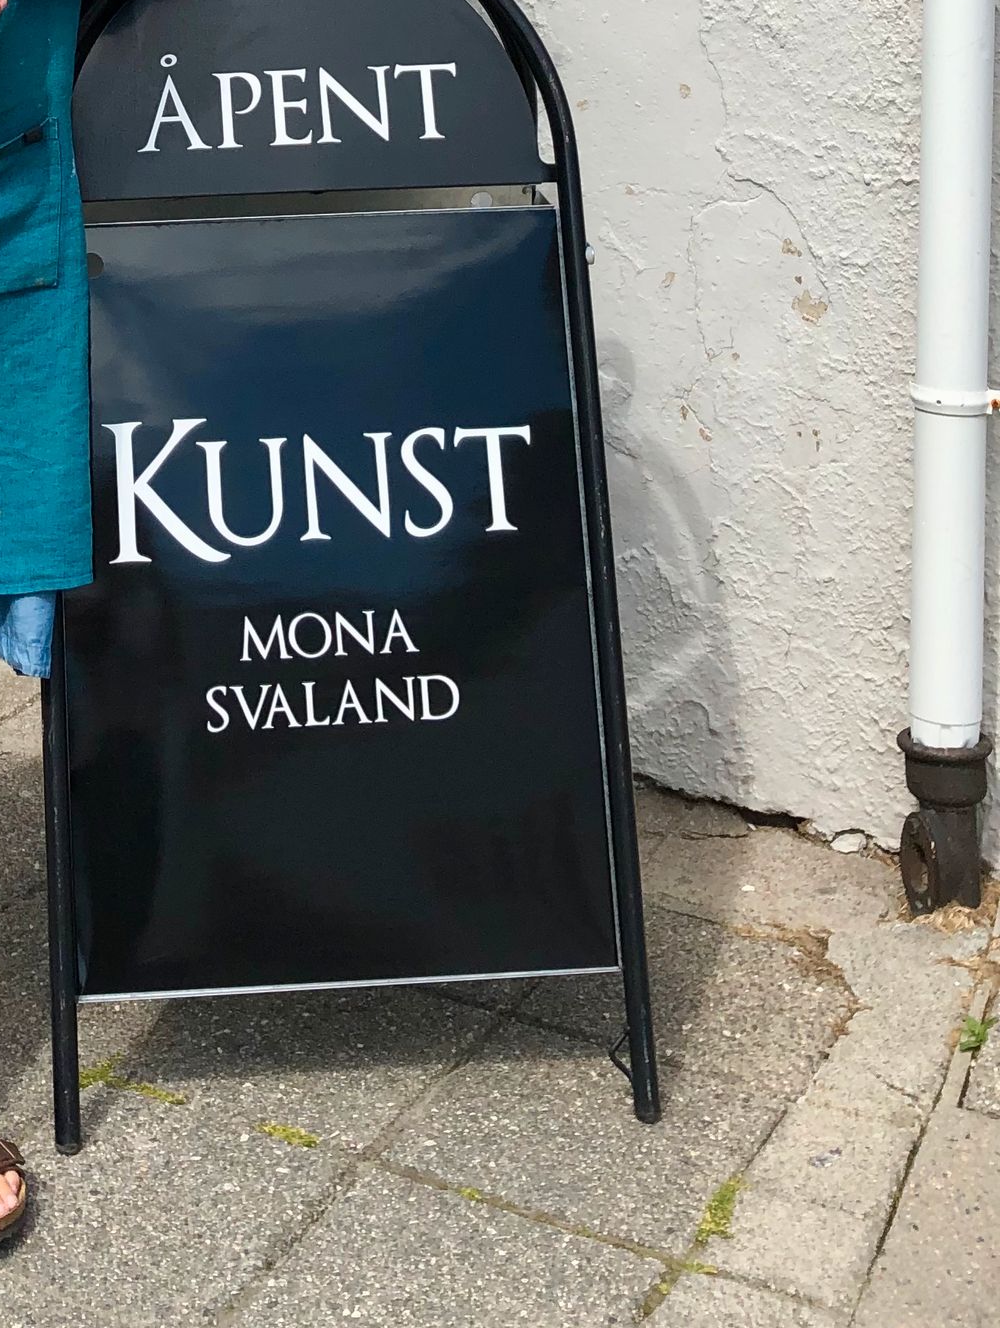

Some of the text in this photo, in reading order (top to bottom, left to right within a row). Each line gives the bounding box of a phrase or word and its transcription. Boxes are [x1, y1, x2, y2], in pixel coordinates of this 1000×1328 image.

[137, 53, 457, 153] ÅPENT
[101, 418, 531, 565] KUNST
[239, 608, 420, 662] MONA
[205, 674, 460, 733] SVALAND
